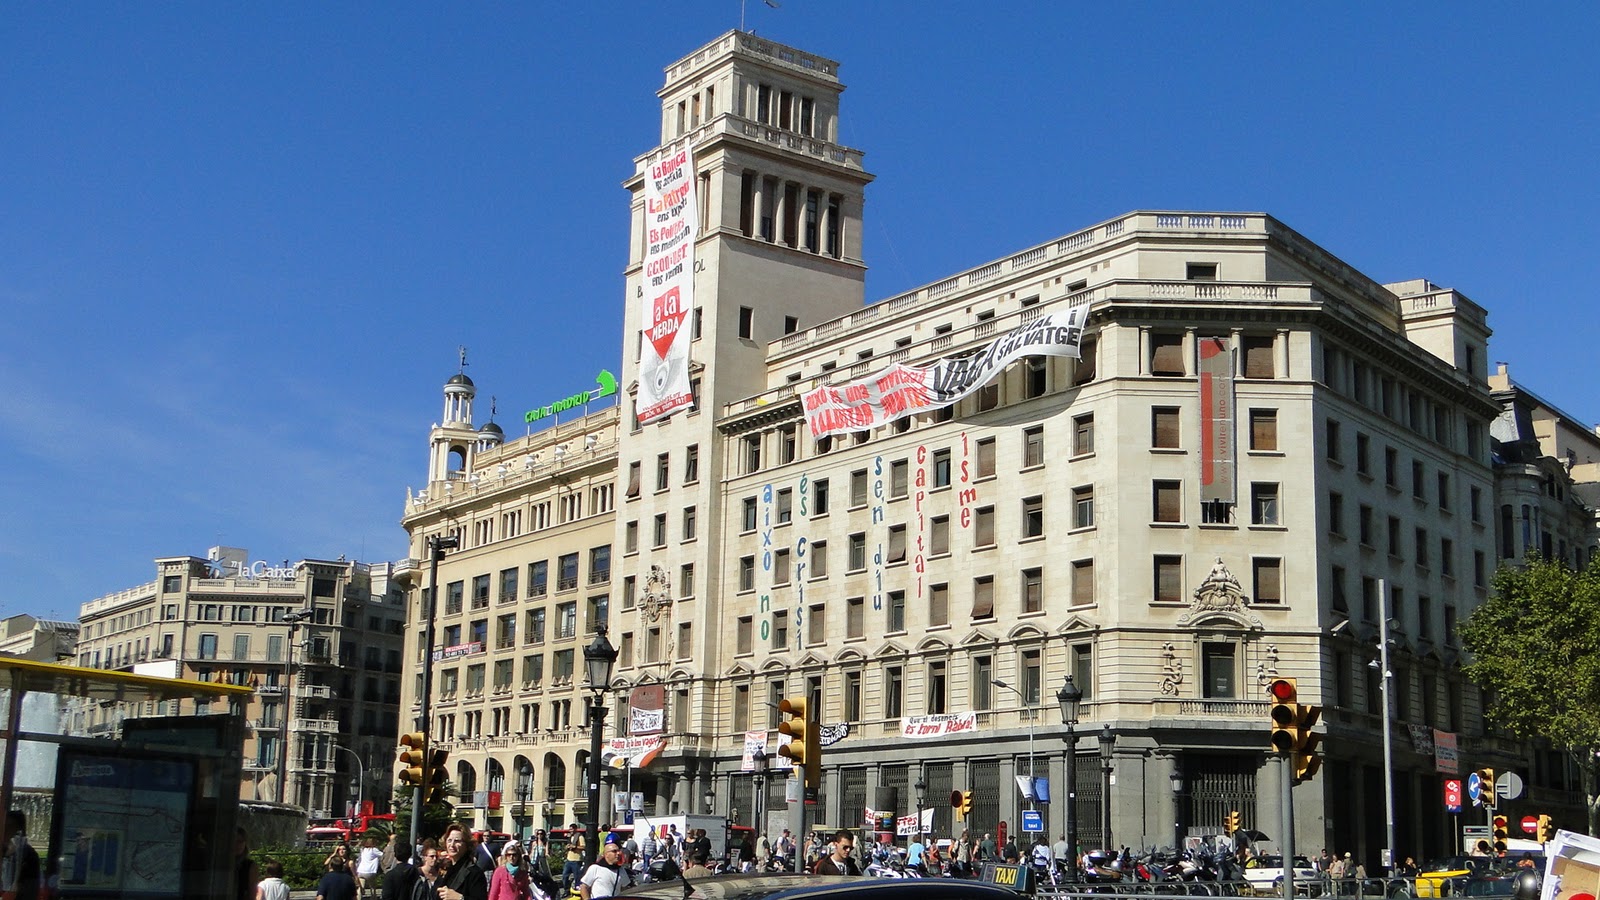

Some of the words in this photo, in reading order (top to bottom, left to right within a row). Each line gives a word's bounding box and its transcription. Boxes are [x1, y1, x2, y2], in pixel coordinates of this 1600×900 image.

[652, 166, 661, 179] La
[649, 198, 663, 213] La
[656, 306, 661, 321] a
[664, 294, 677, 316] la
[652, 316, 679, 342] MERDA
[998, 327, 1081, 361] SALVATGE
[525, 406, 547, 423] CAJA
[552, 391, 590, 412] MADRID
[760, 594, 770, 641] no
[995, 867, 1017, 884] TAXI
